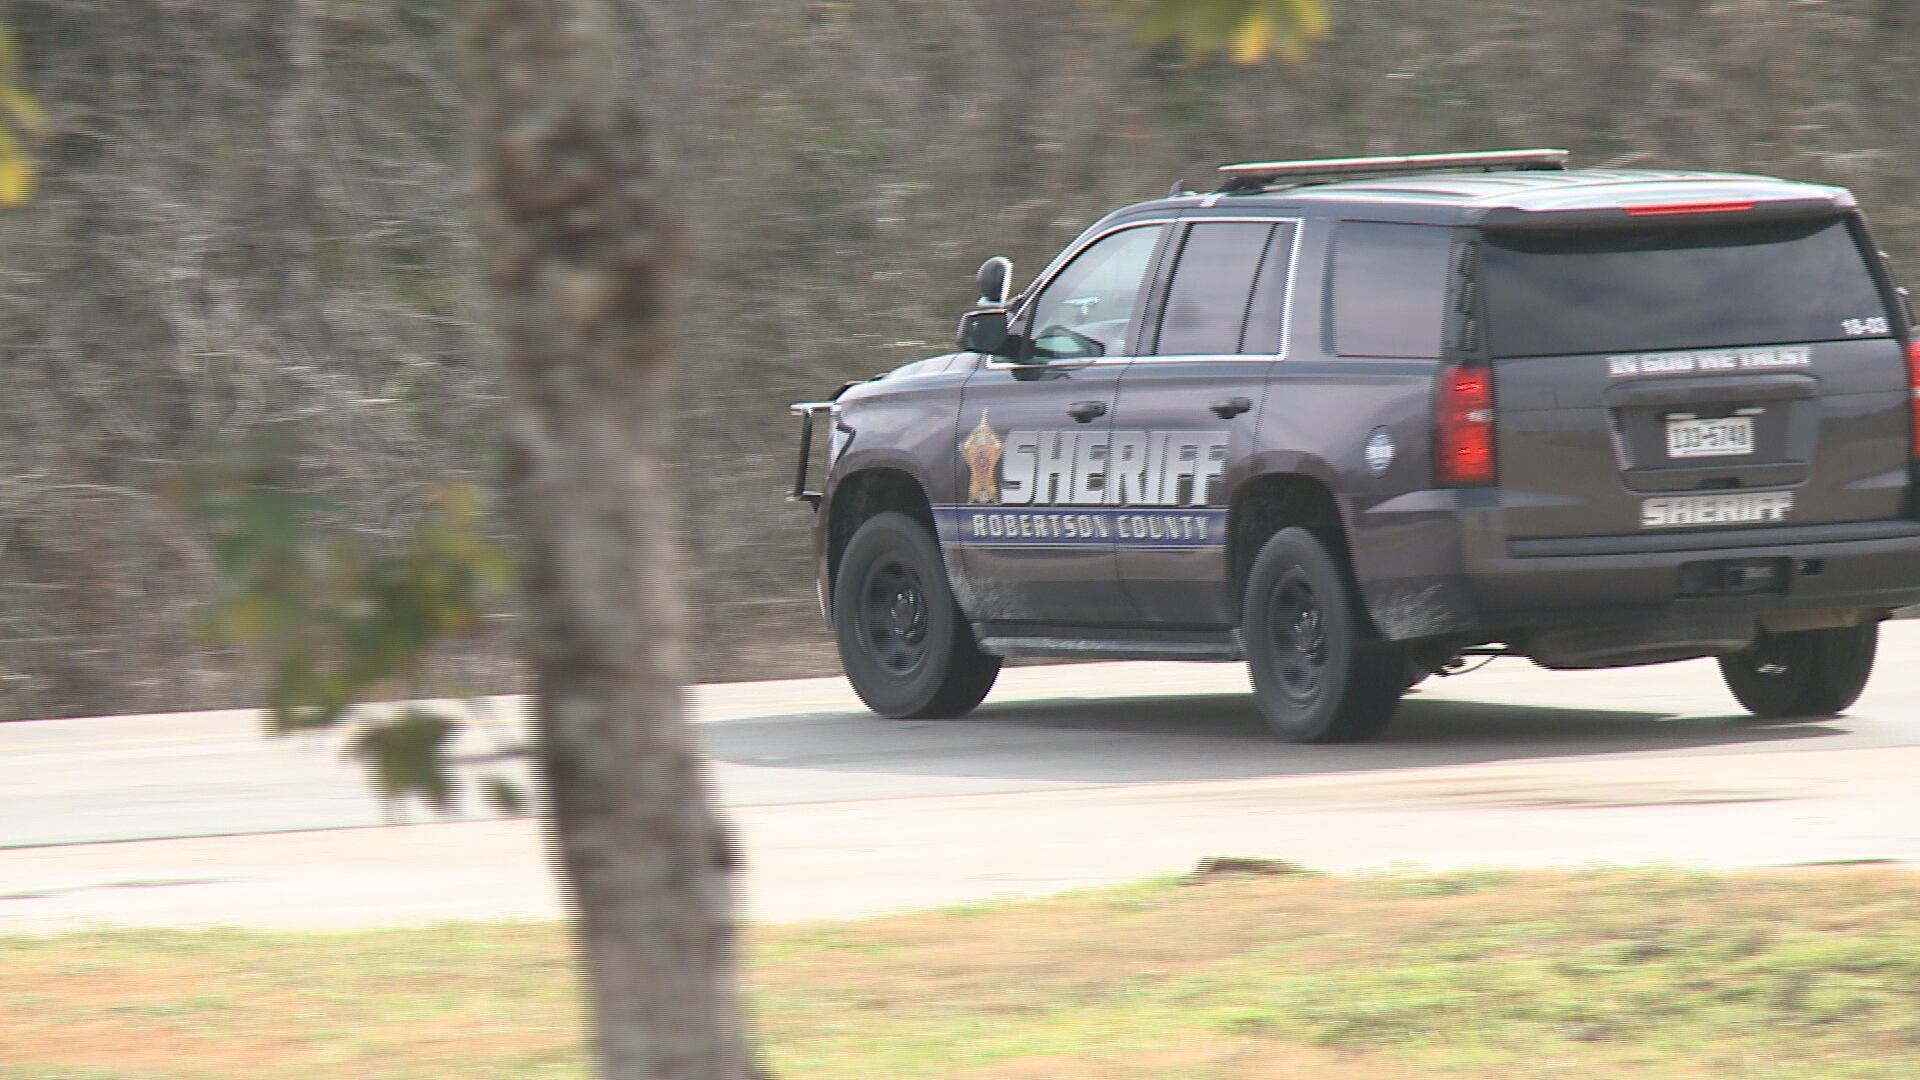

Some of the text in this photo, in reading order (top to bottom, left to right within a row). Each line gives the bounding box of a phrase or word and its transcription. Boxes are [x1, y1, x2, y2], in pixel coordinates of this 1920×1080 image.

[1606, 347, 1811, 377] IN GOD WE TRUST
[1000, 430, 1231, 505] SHERIFF
[972, 513, 1209, 540] ROBERTSON COUNTY
[1640, 492, 1794, 528] SHERIFF
